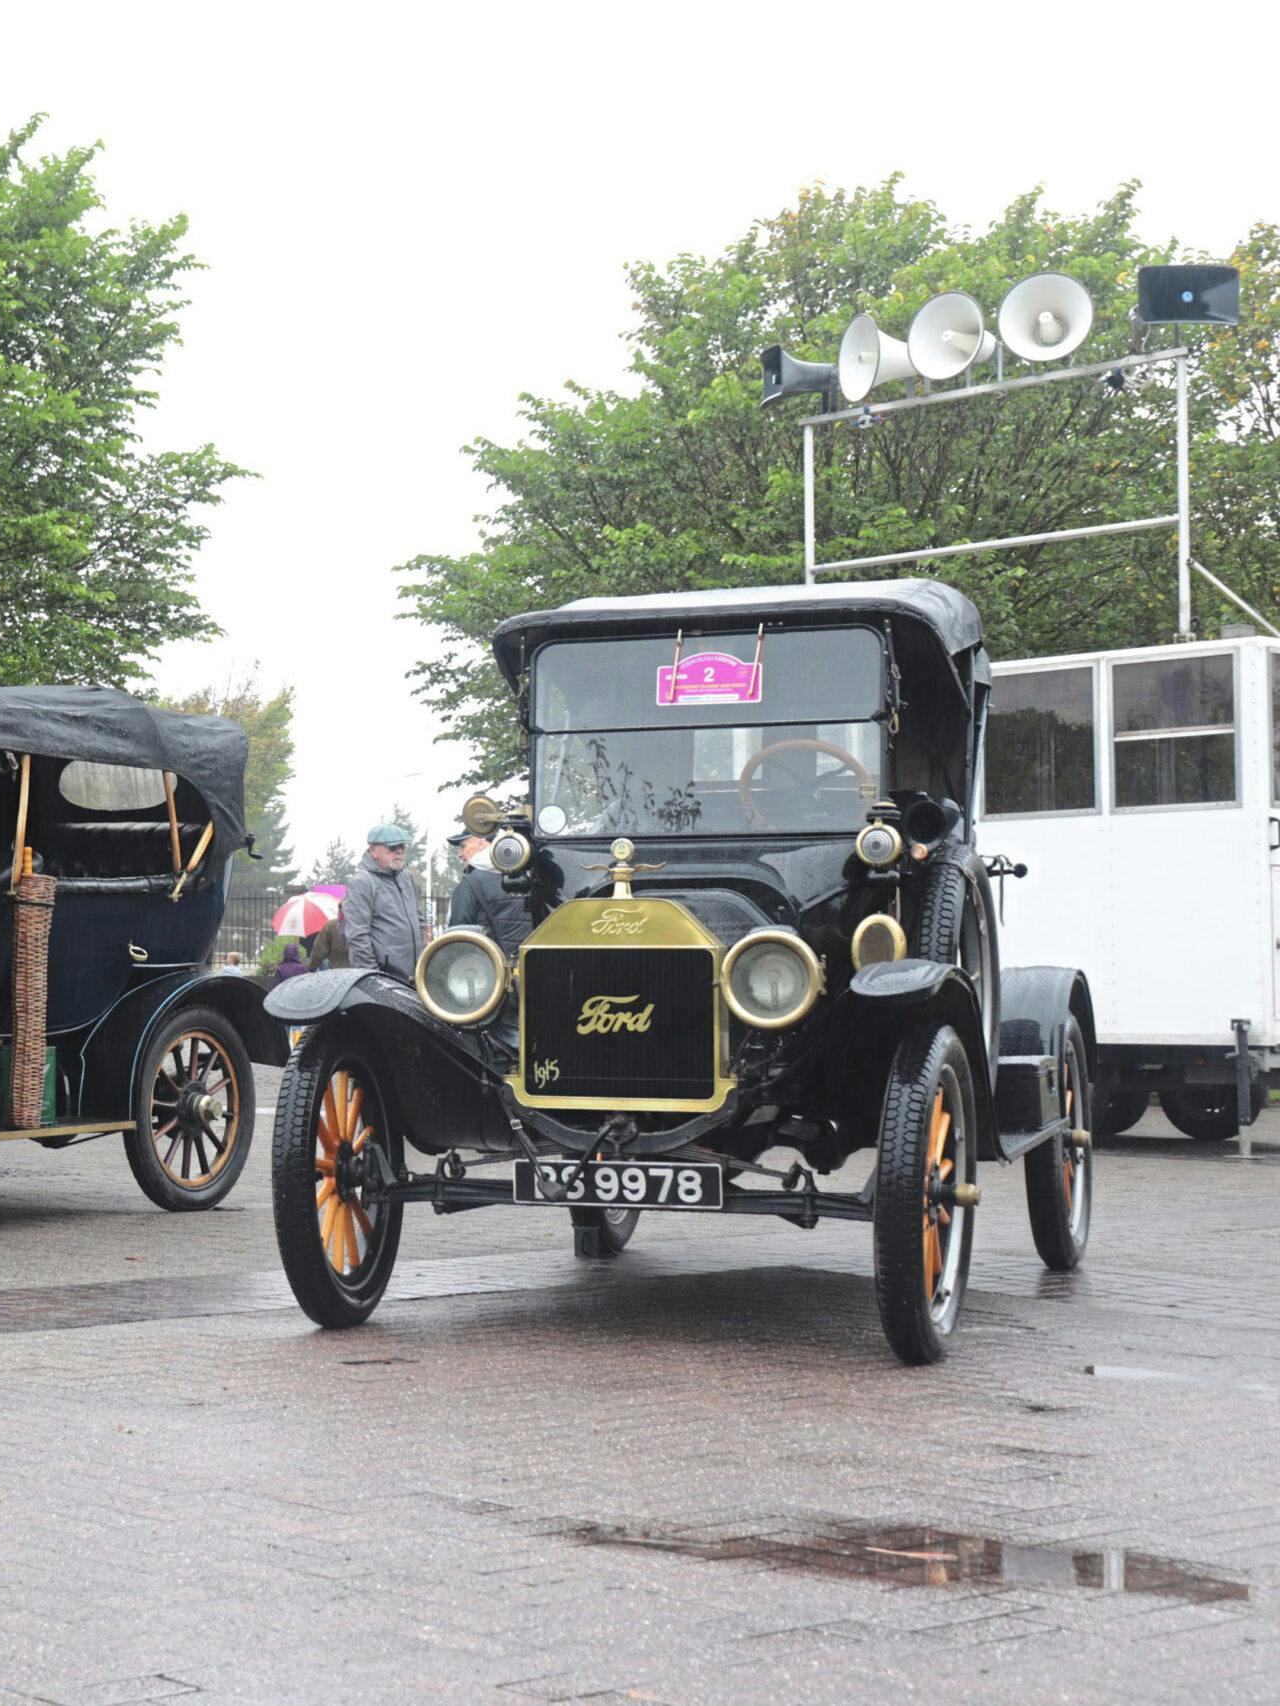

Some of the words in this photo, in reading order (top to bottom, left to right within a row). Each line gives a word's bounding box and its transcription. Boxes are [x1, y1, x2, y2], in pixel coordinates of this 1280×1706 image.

[704, 667, 715, 682] 2
[591, 908, 648, 936] Ford
[576, 994, 655, 1035] Ford
[533, 1058, 560, 1089] 1915
[594, 1166, 704, 1204] 9978
